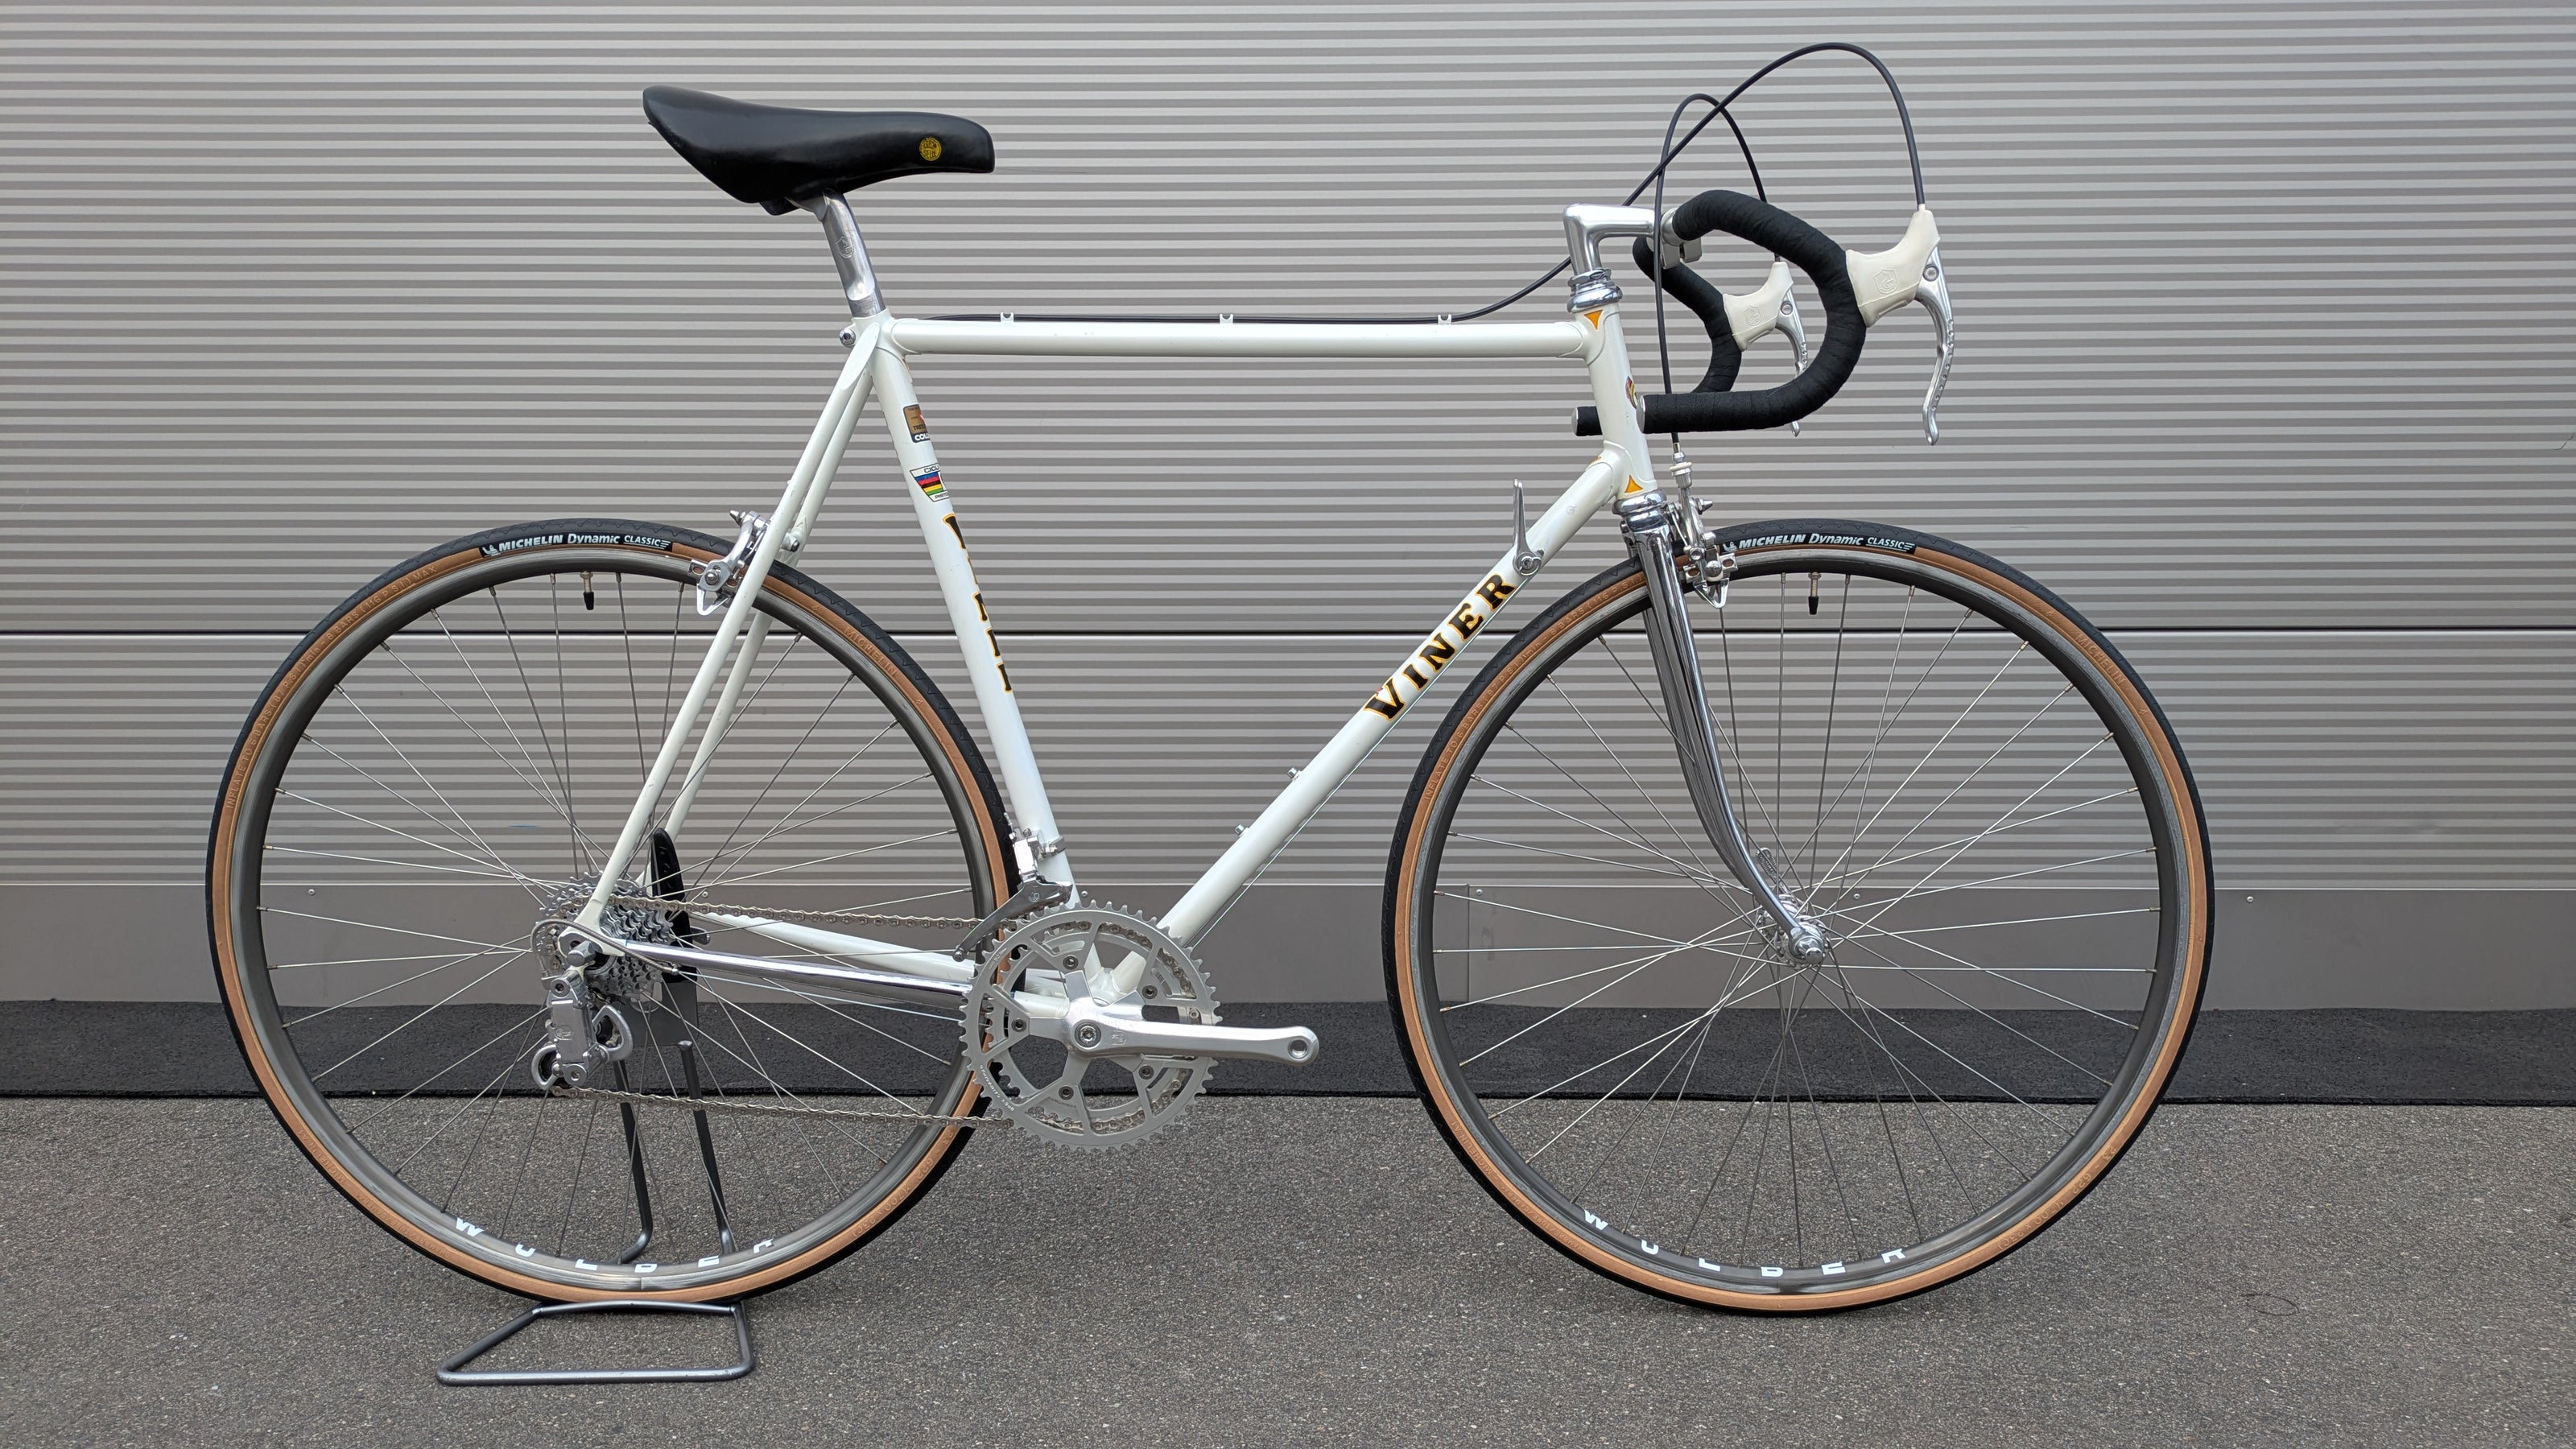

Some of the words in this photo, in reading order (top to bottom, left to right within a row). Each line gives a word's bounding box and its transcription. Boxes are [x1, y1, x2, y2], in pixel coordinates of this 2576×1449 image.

[499, 535, 564, 551] MICHELIN
[568, 533, 620, 545] Dynamic
[624, 535, 661, 547] CLASSIC
[1739, 534, 1806, 549] MICHELIN
[1809, 533, 1864, 546] Dynamic
[1868, 536, 1905, 549] CLASSIC
[1363, 574, 1517, 721] VINER
